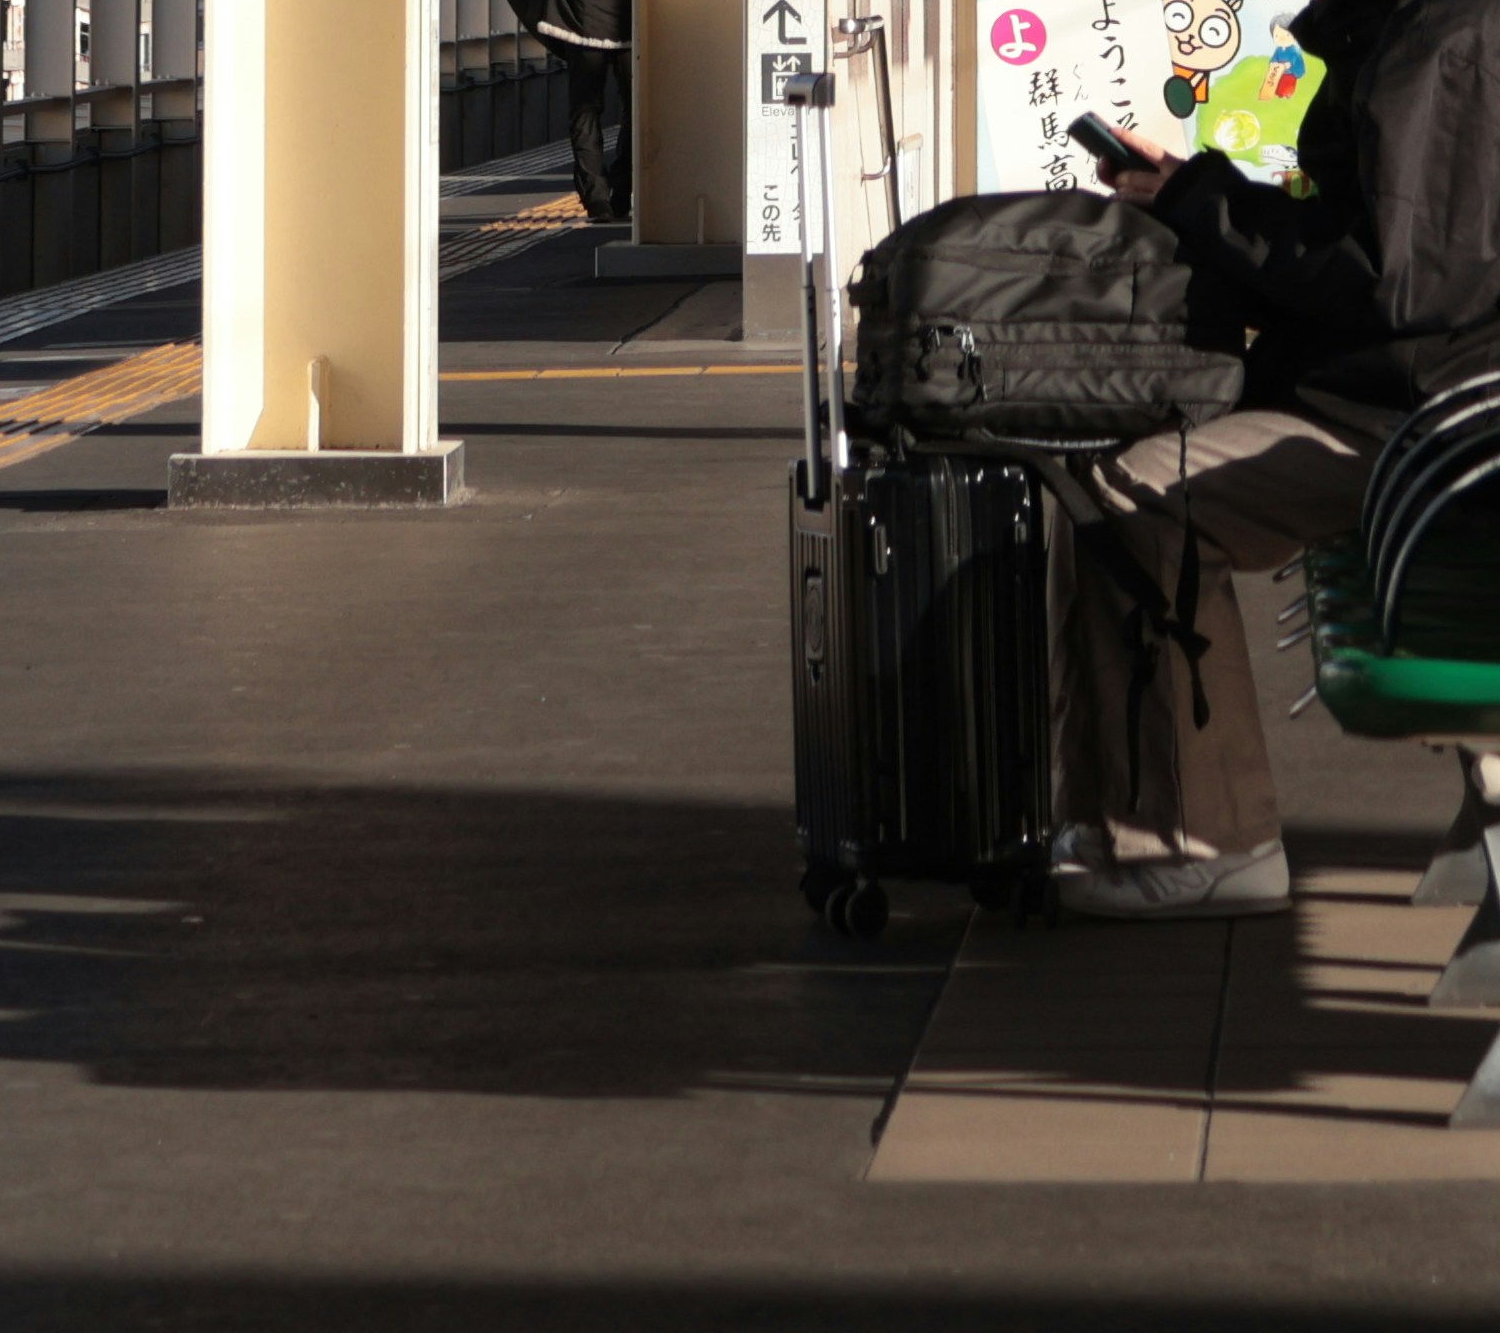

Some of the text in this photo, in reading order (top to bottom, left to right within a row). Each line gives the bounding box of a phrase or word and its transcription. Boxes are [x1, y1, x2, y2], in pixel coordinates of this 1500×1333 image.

[999, 14, 1037, 59] よ
[762, 184, 781, 243] この先
